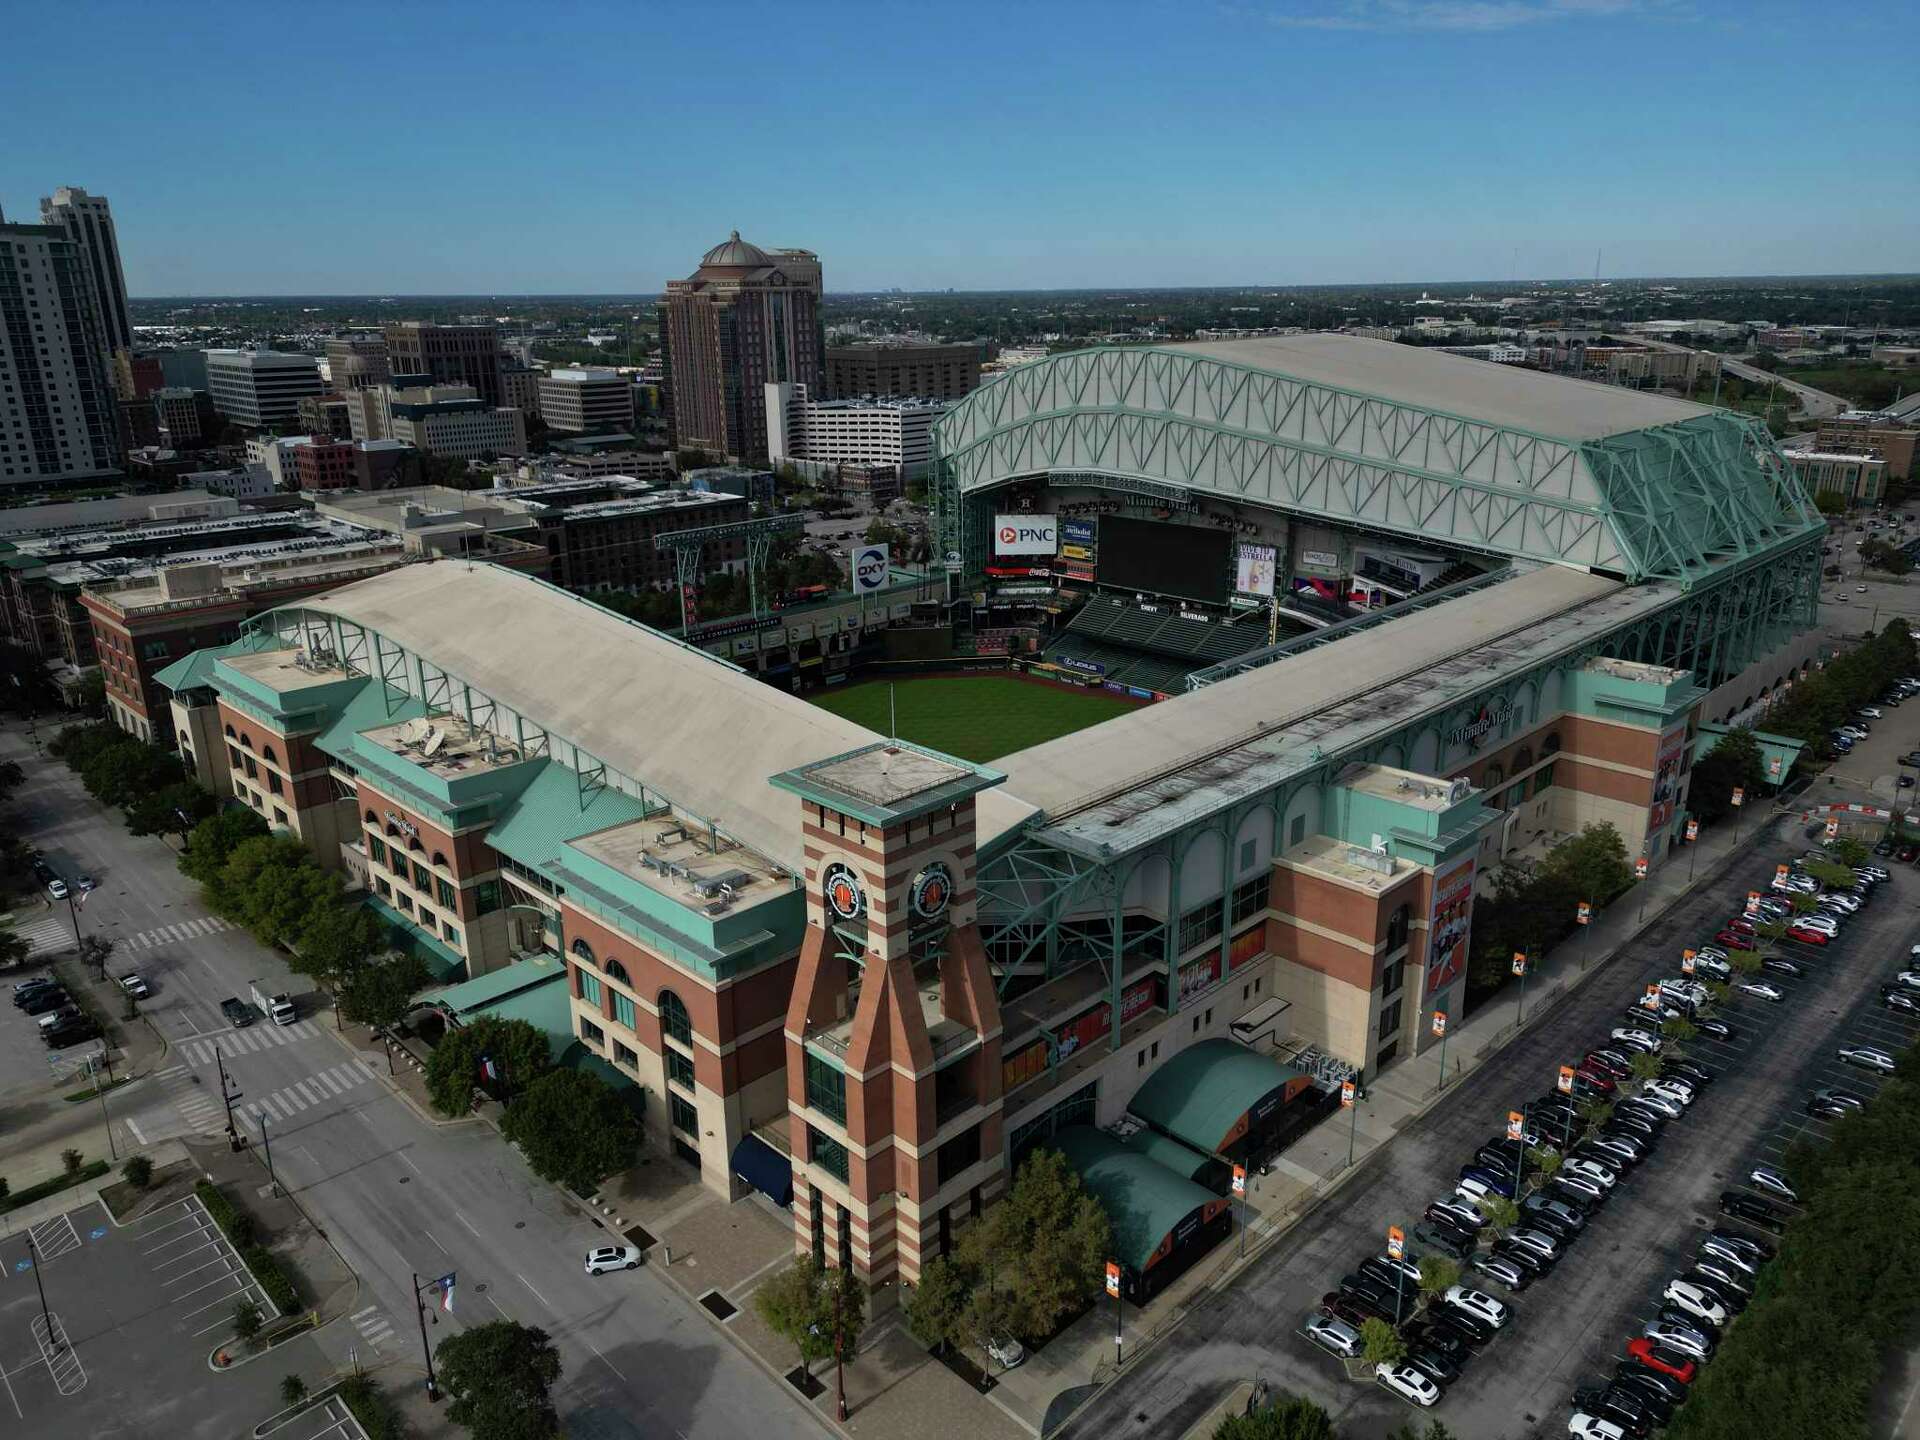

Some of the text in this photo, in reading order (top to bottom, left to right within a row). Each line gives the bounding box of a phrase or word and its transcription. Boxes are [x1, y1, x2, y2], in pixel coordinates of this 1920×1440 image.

[1018, 528, 1054, 542] PNC
[857, 562, 886, 577] OXY
[1140, 604, 1159, 613] CHEVY
[1180, 611, 1209, 622] SILVERADO
